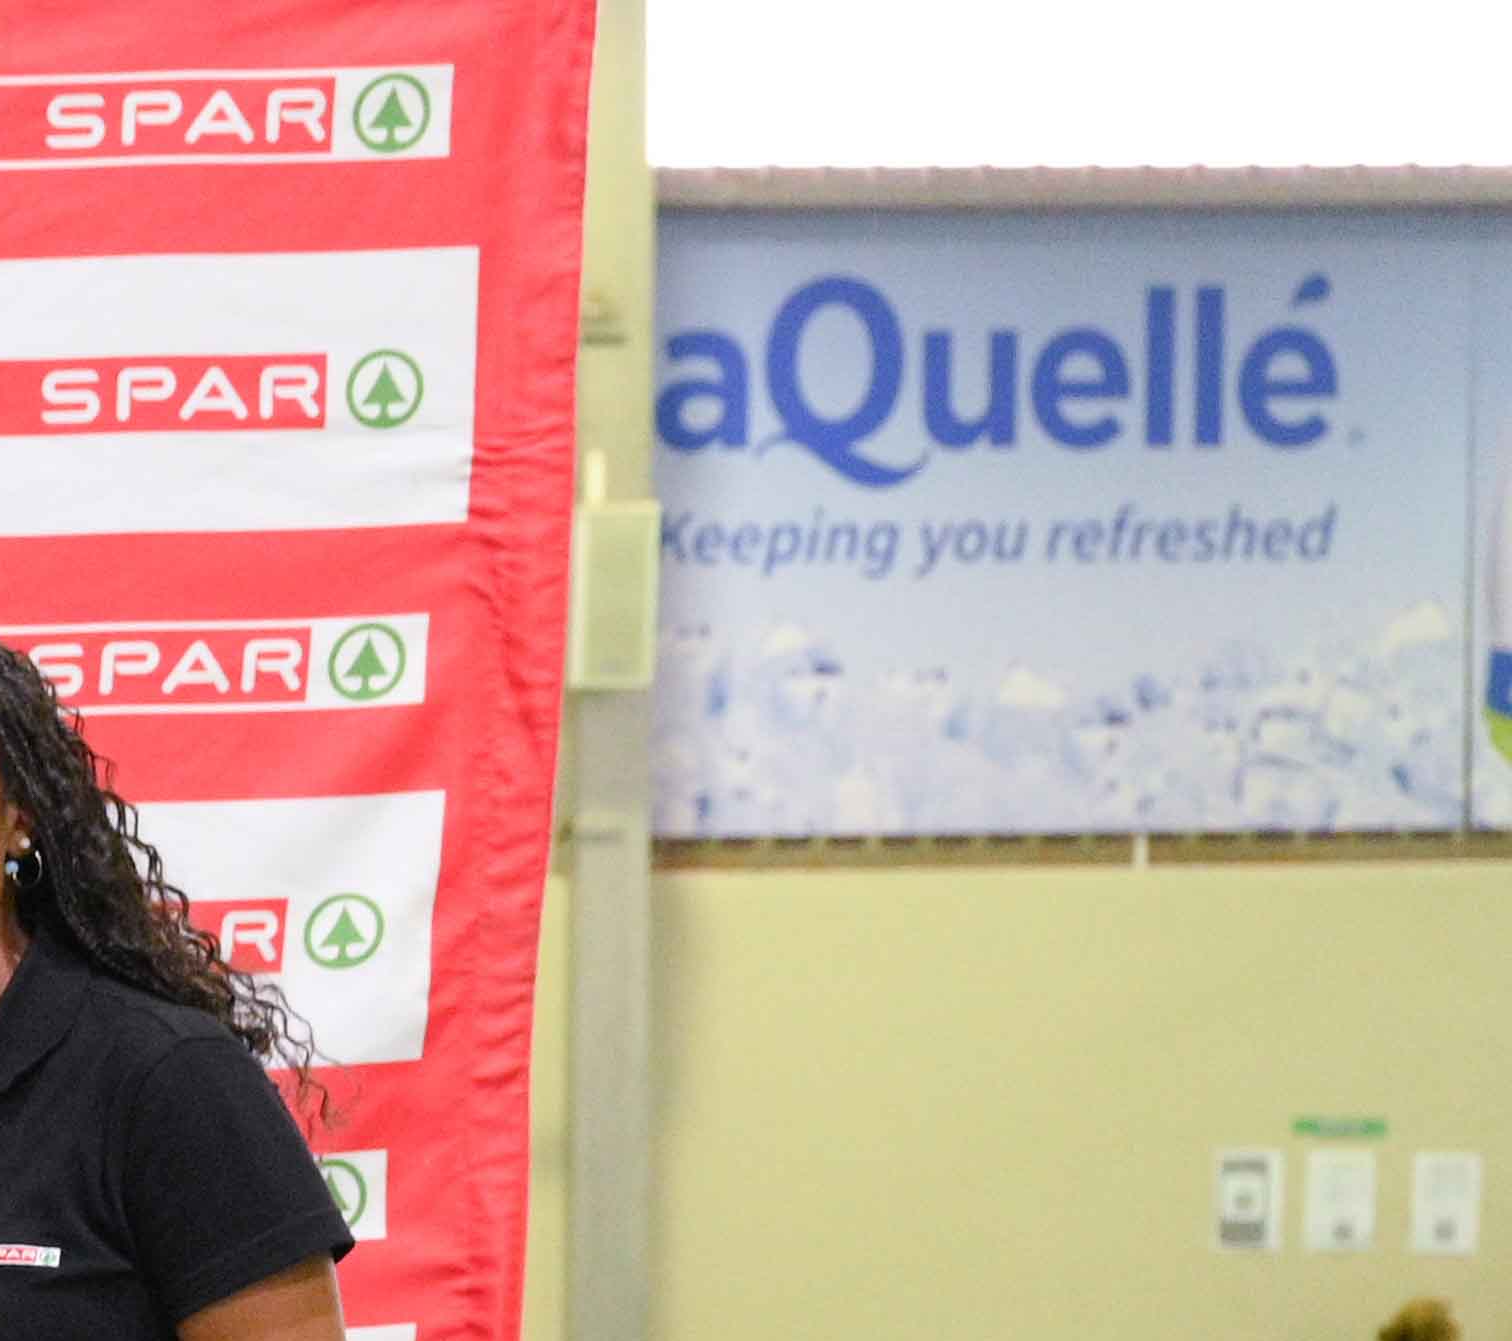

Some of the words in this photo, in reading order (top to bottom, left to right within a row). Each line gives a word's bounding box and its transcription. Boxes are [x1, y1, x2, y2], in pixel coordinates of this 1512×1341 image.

[47, 89, 326, 148] SPAR
[43, 366, 319, 423] SPAR
[656, 272, 1339, 488] aQuellé
[660, 508, 899, 580] Keeping
[914, 515, 1028, 580] you
[1046, 503, 1338, 565] refreshed
[29, 638, 303, 698] SPAR
